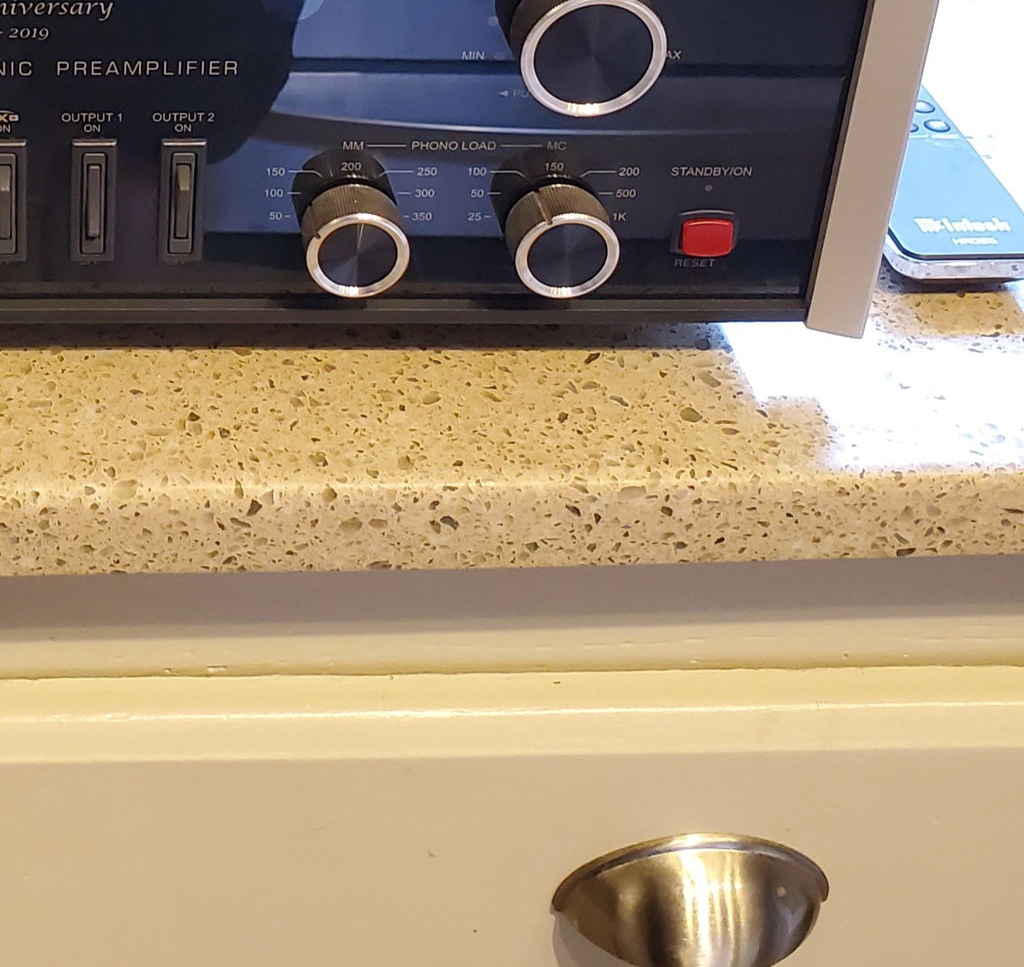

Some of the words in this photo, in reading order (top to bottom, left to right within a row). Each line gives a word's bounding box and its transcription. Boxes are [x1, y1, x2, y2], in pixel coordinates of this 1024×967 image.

[8, 27, 49, 41] 2019
[461, 50, 485, 61] MIN
[666, 50, 682, 60] AX
[57, 60, 239, 76] PREAMPLIFIER
[61, 112, 114, 123] OUTPUT
[117, 113, 123, 123] 1
[152, 112, 204, 123] OUTPUT
[207, 113, 215, 123] 2
[83, 123, 101, 133] ON
[175, 123, 192, 132] ON
[342, 141, 364, 151] MM
[411, 141, 458, 151] PHONO
[461, 141, 497, 151] LOAD
[546, 141, 568, 151] MC
[340, 162, 362, 171] 200
[544, 162, 564, 172] 150
[266, 167, 285, 176] 150
[417, 167, 438, 176] 250
[467, 167, 487, 176] 100
[618, 167, 640, 176] 200
[671, 166, 753, 177] STANDBY/ON
[264, 189, 284, 198] 100
[415, 189, 435, 198] 300
[471, 189, 484, 198] 50
[615, 189, 637, 198] 500
[269, 212, 282, 221] 50
[411, 212, 433, 221] 350
[467, 212, 482, 221] 25
[612, 212, 627, 221] 1K
[674, 258, 716, 268] RESET
